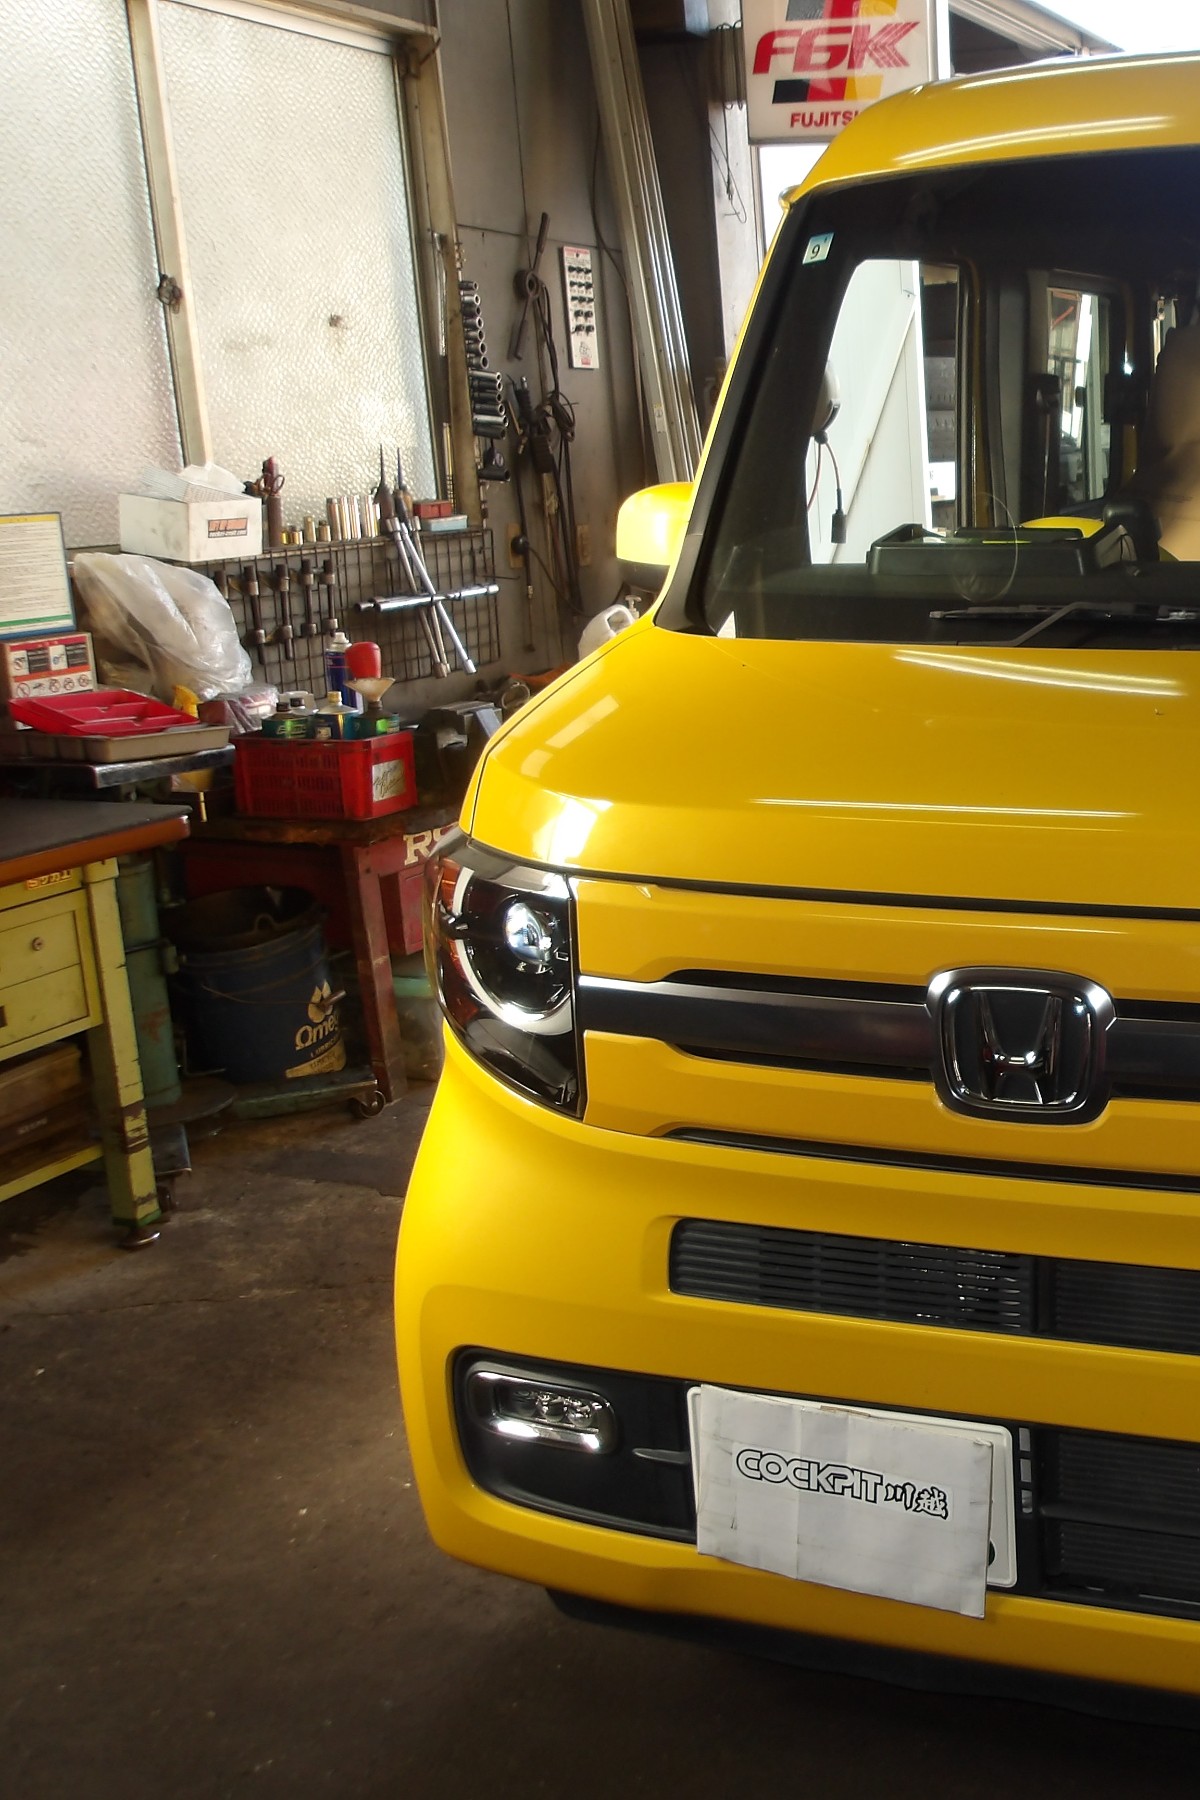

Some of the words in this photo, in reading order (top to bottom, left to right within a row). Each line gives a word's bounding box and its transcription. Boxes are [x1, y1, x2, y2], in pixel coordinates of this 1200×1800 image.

[752, 21, 920, 75] FGK
[810, 243, 820, 260] 9
[736, 1448, 884, 1504] COCKPIT
